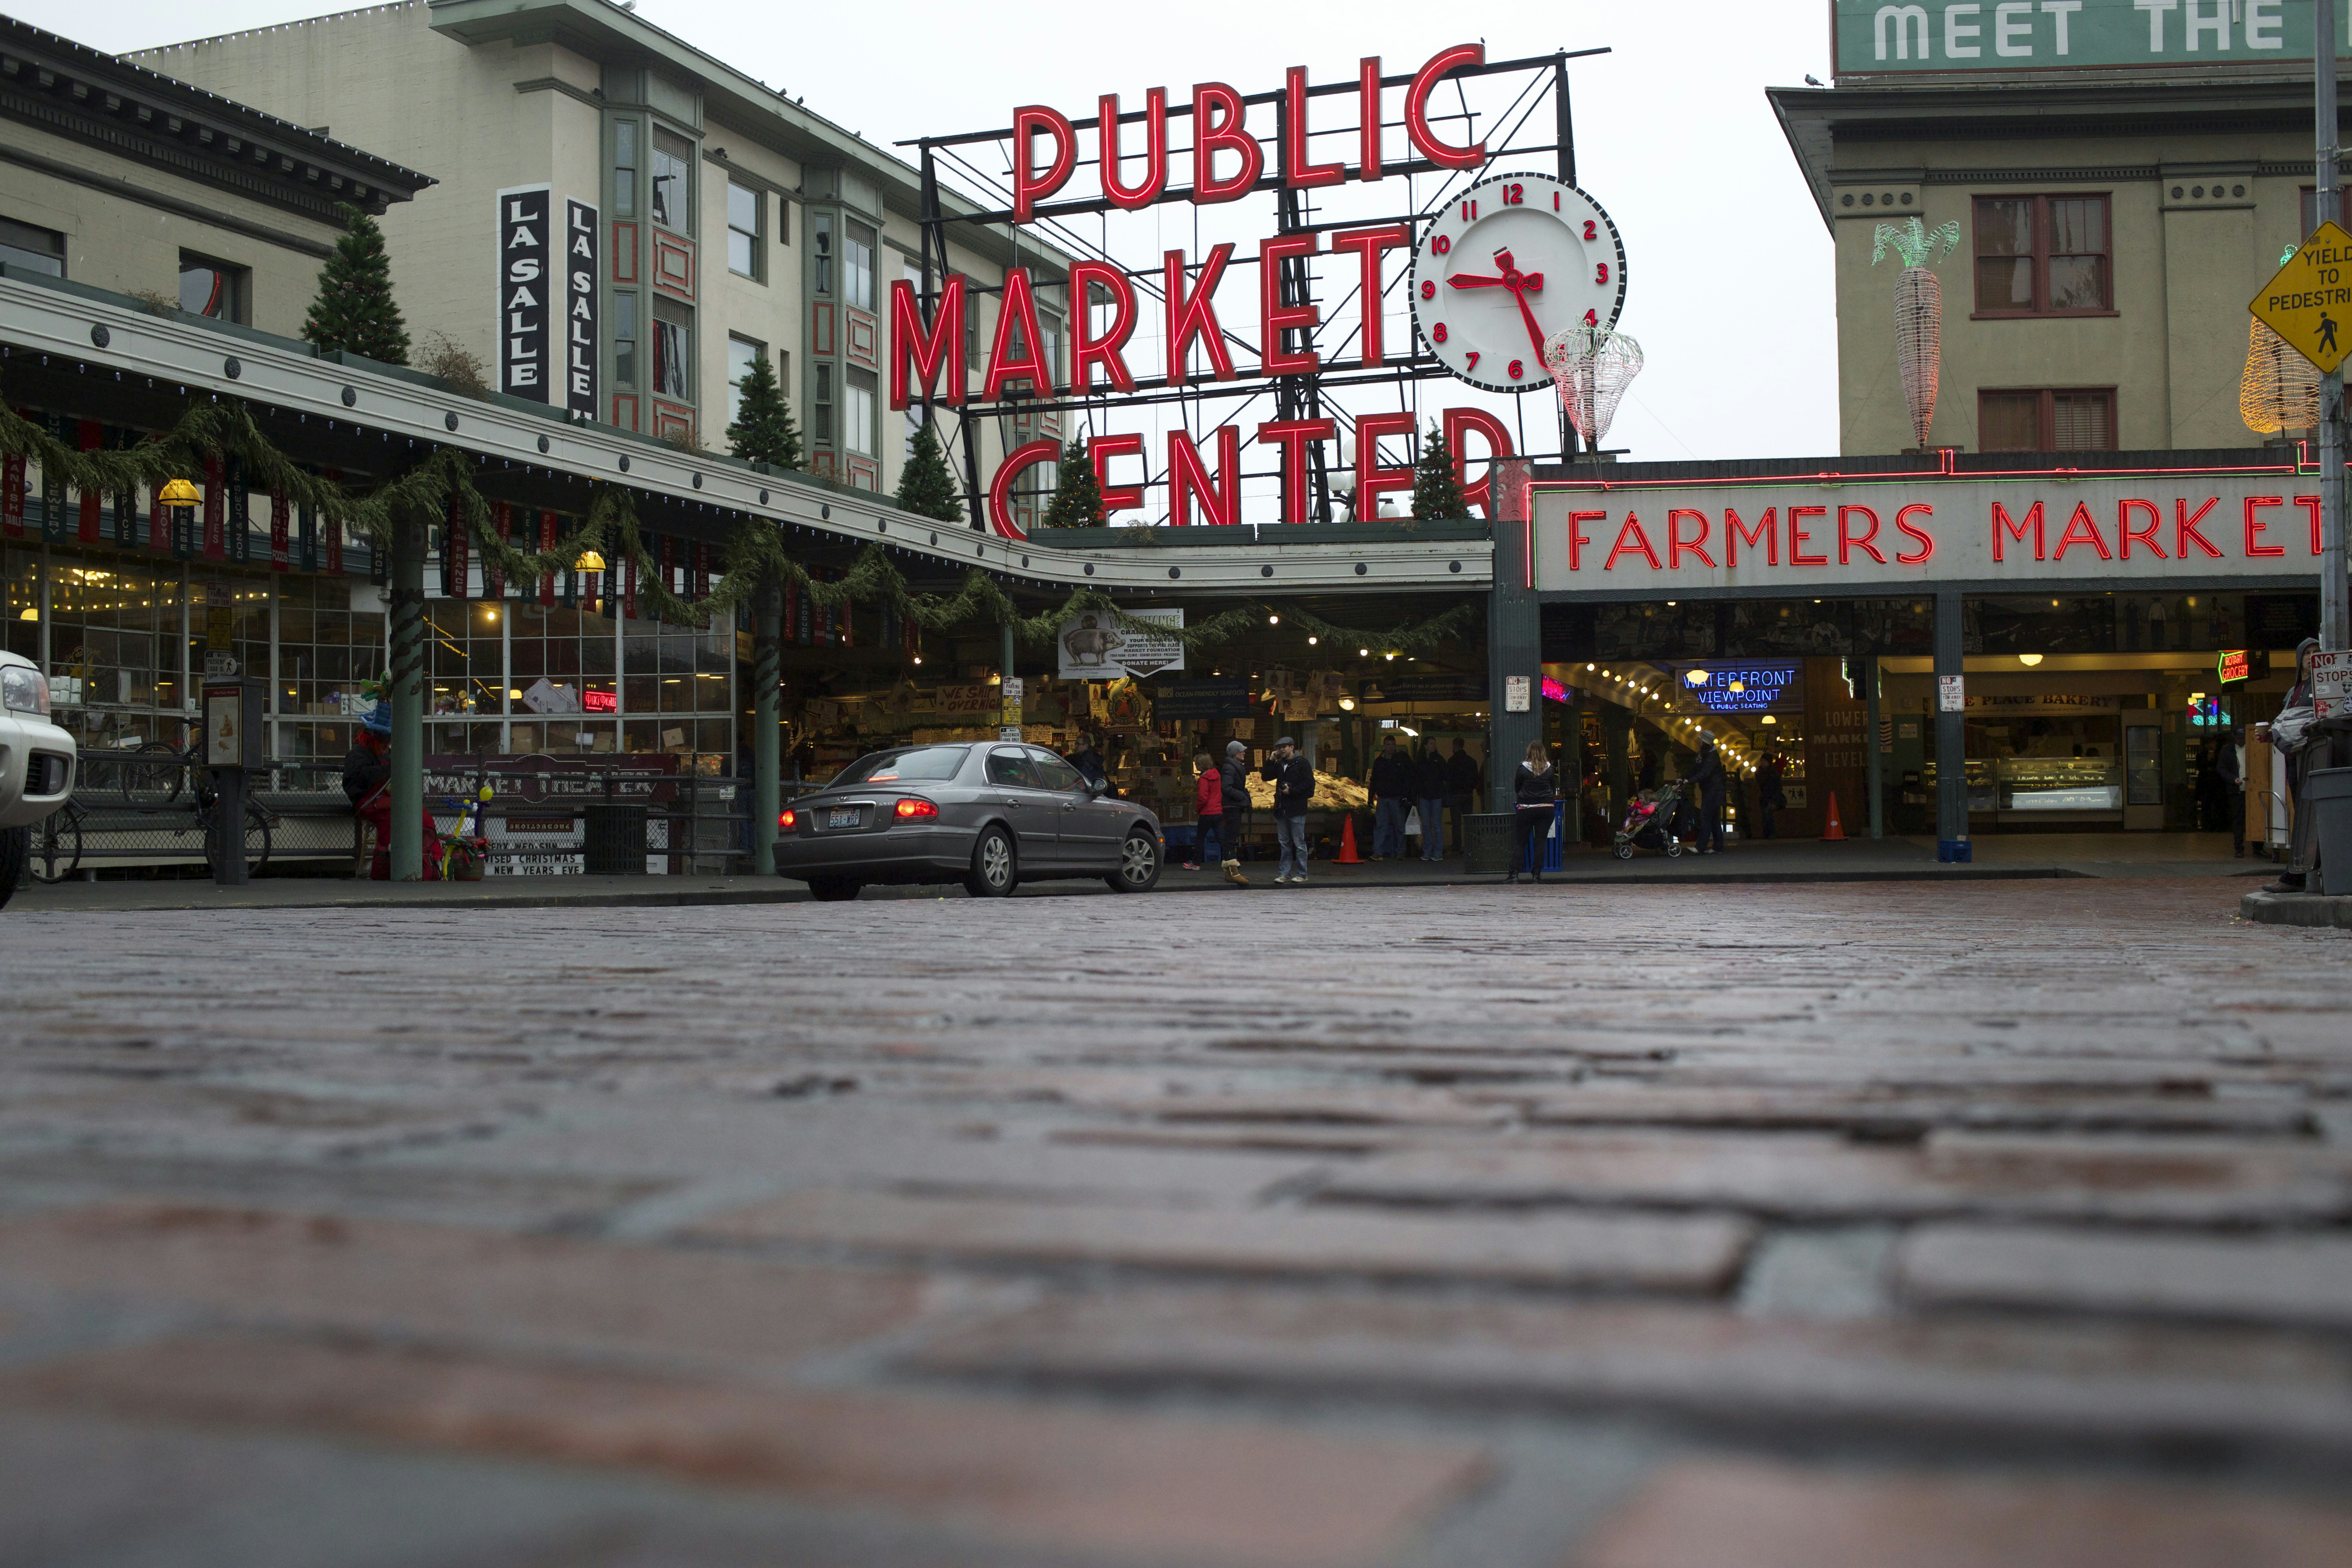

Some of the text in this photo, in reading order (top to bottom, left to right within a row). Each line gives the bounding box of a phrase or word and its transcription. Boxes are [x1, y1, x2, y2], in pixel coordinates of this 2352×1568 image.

[1875, 0, 2283, 60] MEET THE
[1013, 43, 1486, 225] PUBLIC
[1503, 183, 1523, 205] 12
[1554, 192, 1559, 211] 1
[1462, 200, 1477, 220] 11
[1584, 220, 1597, 240] 2
[1432, 235, 1450, 255] 10
[1596, 263, 1608, 283] 3
[2318, 269, 2339, 285] TO
[1421, 280, 1436, 300] 9
[508, 259, 539, 386] SALLE
[891, 225, 1410, 410] MARKET
[572, 272, 591, 396] SALLE
[1433, 323, 1448, 343] 8
[1466, 352, 1480, 371] 7
[1508, 360, 1523, 379] 6
[10, 453, 19, 512] PANISH
[989, 408, 1514, 541] CENTER
[213, 481, 222, 543] AGAVES
[180, 506, 188, 551] HEESE
[1569, 496, 2321, 570] FARMERS MARKET
[375, 544, 383, 575] SHOP
[455, 546, 464, 592] FRANCE
[2225, 653, 2243, 666] ROTARY
[2315, 655, 2333, 667] NO
[2222, 665, 2248, 680] GROCERY
[943, 685, 994, 699] WE SHIP
[1698, 689, 1781, 703] VIEWPOINT
[1982, 695, 2112, 708] PLACE BAKERY
[948, 698, 1001, 711] OVERNIGH
[1111, 715, 1123, 723] PLACE
[1826, 711, 1868, 726] LOWER
[1814, 734, 1868, 744] MARK
[1824, 752, 1868, 767] LEVEL
[485, 855, 511, 863] VISED
[494, 866, 579, 875] NEW YEARS EVE
